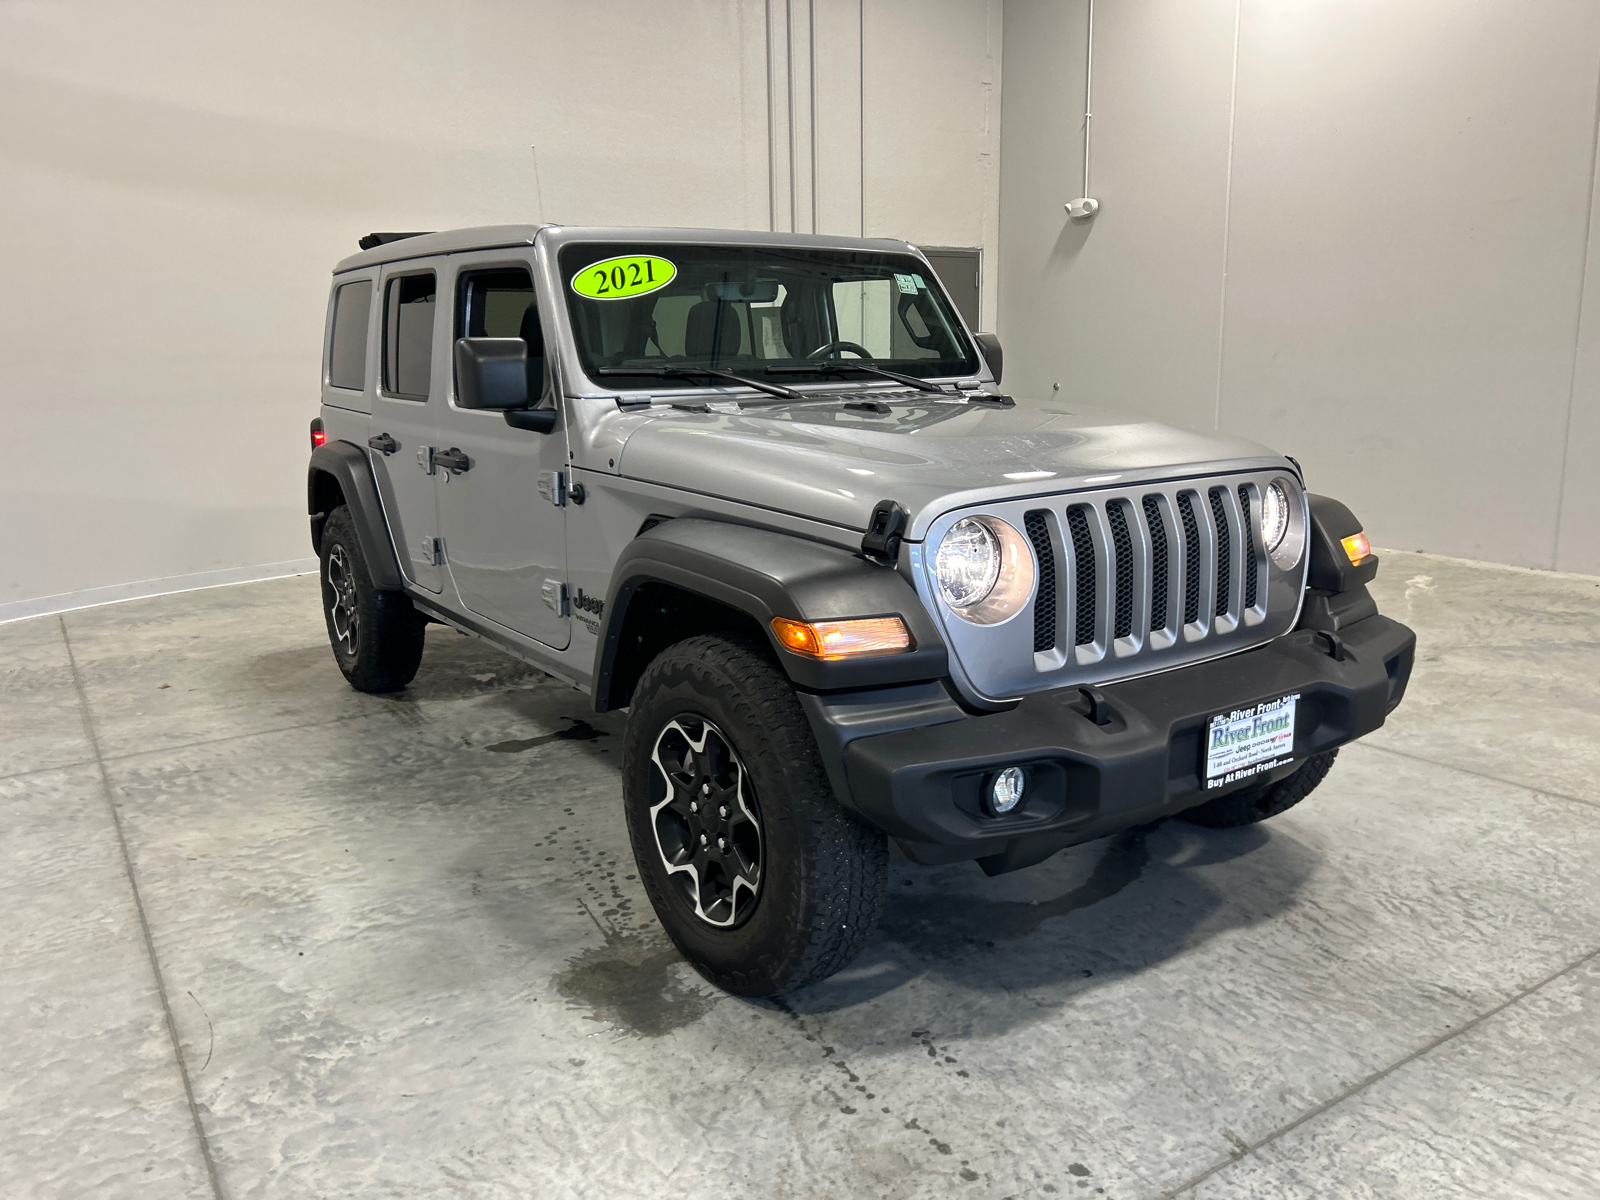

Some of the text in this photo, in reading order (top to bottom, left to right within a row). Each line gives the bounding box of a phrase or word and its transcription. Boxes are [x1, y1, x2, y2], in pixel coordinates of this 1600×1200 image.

[593, 259, 657, 294] 2021
[573, 587, 605, 620] Jeep
[1230, 709, 1255, 722] River
[1257, 699, 1281, 715] Front
[1235, 745, 1251, 754] Jeep
[1207, 778, 1224, 789] Buy
[1225, 773, 1235, 783] At
[1235, 767, 1255, 780] River
